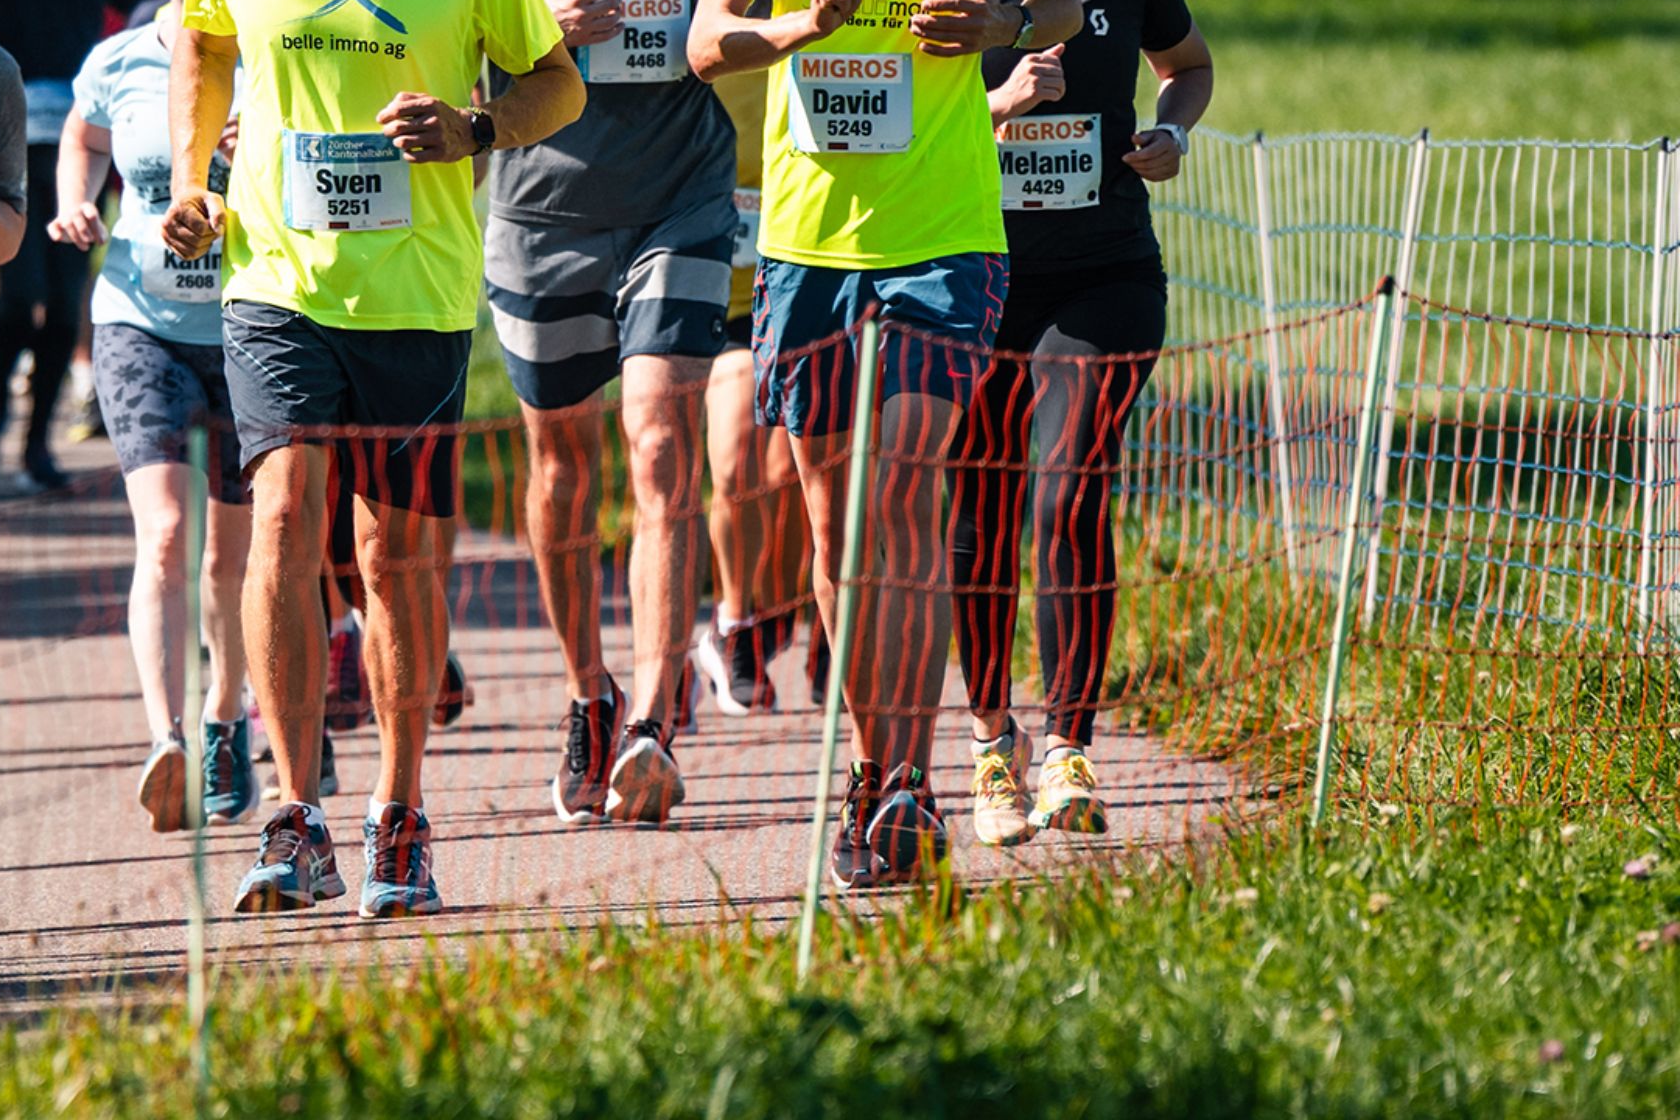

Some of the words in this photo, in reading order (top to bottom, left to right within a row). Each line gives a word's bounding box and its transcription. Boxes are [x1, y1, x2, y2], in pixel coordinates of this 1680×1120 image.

[282, 34, 324, 50] belle
[330, 34, 379, 54] immo
[384, 42, 406, 60] ag
[623, 27, 667, 50] Res
[626, 54, 666, 68] 4468
[802, 59, 897, 78] MIGROS
[813, 88, 887, 115] David
[827, 120, 872, 136] 5249
[995, 120, 1087, 141] MIGROS
[328, 140, 364, 150] Zürcher
[328, 147, 395, 159] Kantonalbank
[998, 149, 1093, 175] Melanie
[316, 169, 382, 194] Sven
[1022, 179, 1064, 195] 4429
[328, 199, 370, 215] 5251
[176, 274, 215, 288] 2608
